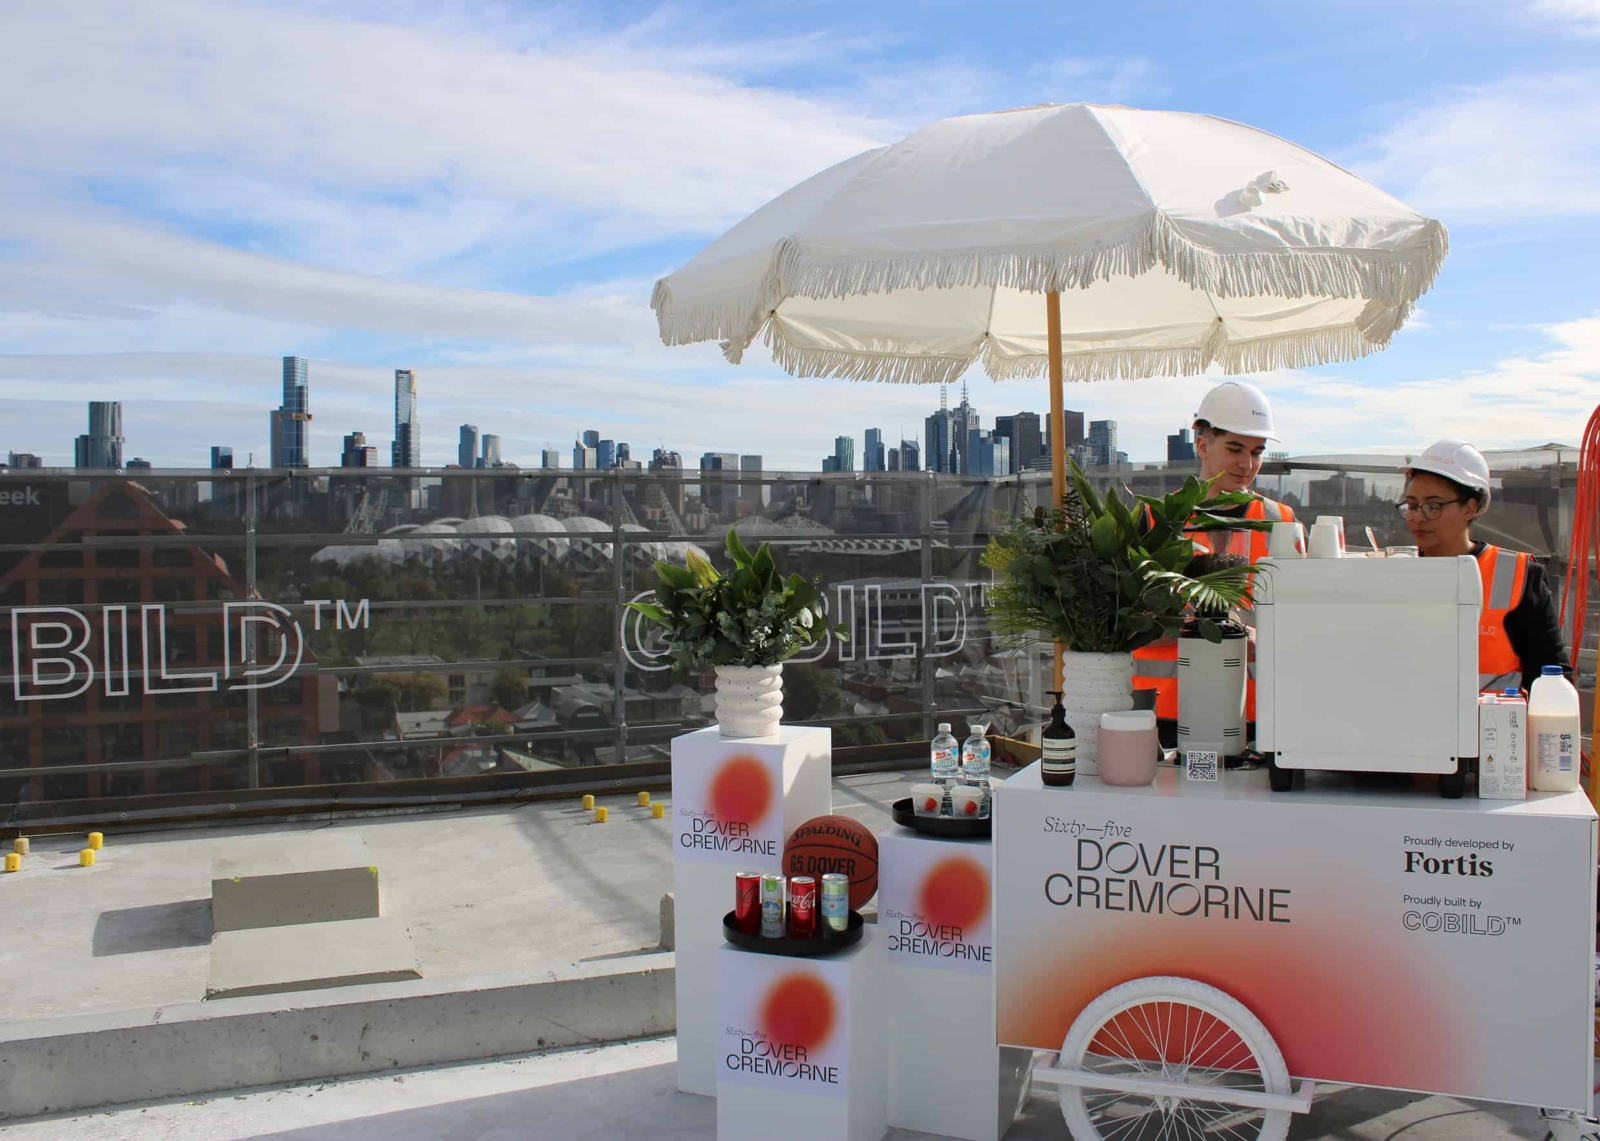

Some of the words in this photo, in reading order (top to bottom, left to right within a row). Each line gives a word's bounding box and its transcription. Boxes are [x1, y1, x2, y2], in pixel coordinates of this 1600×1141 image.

[693, 818, 749, 837] DOVER
[793, 825, 862, 848] SPALDING
[680, 833, 776, 856] CREMORNE
[1403, 835, 1442, 848] Proudly
[1444, 838, 1499, 850] developed
[1502, 840, 1515, 852] by
[790, 854, 804, 873] 65
[807, 855, 856, 877] DOVER
[1077, 838, 1220, 880] DOVER
[1404, 850, 1493, 877] Fortis
[1044, 872, 1291, 923] CREMORNE
[1403, 894, 1441, 907] Proudly
[1444, 896, 1467, 907] built
[1469, 898, 1482, 910] by
[900, 920, 962, 942] DOVER
[741, 1038, 807, 1062] DOVER
[726, 1053, 839, 1084] CREMORNE
